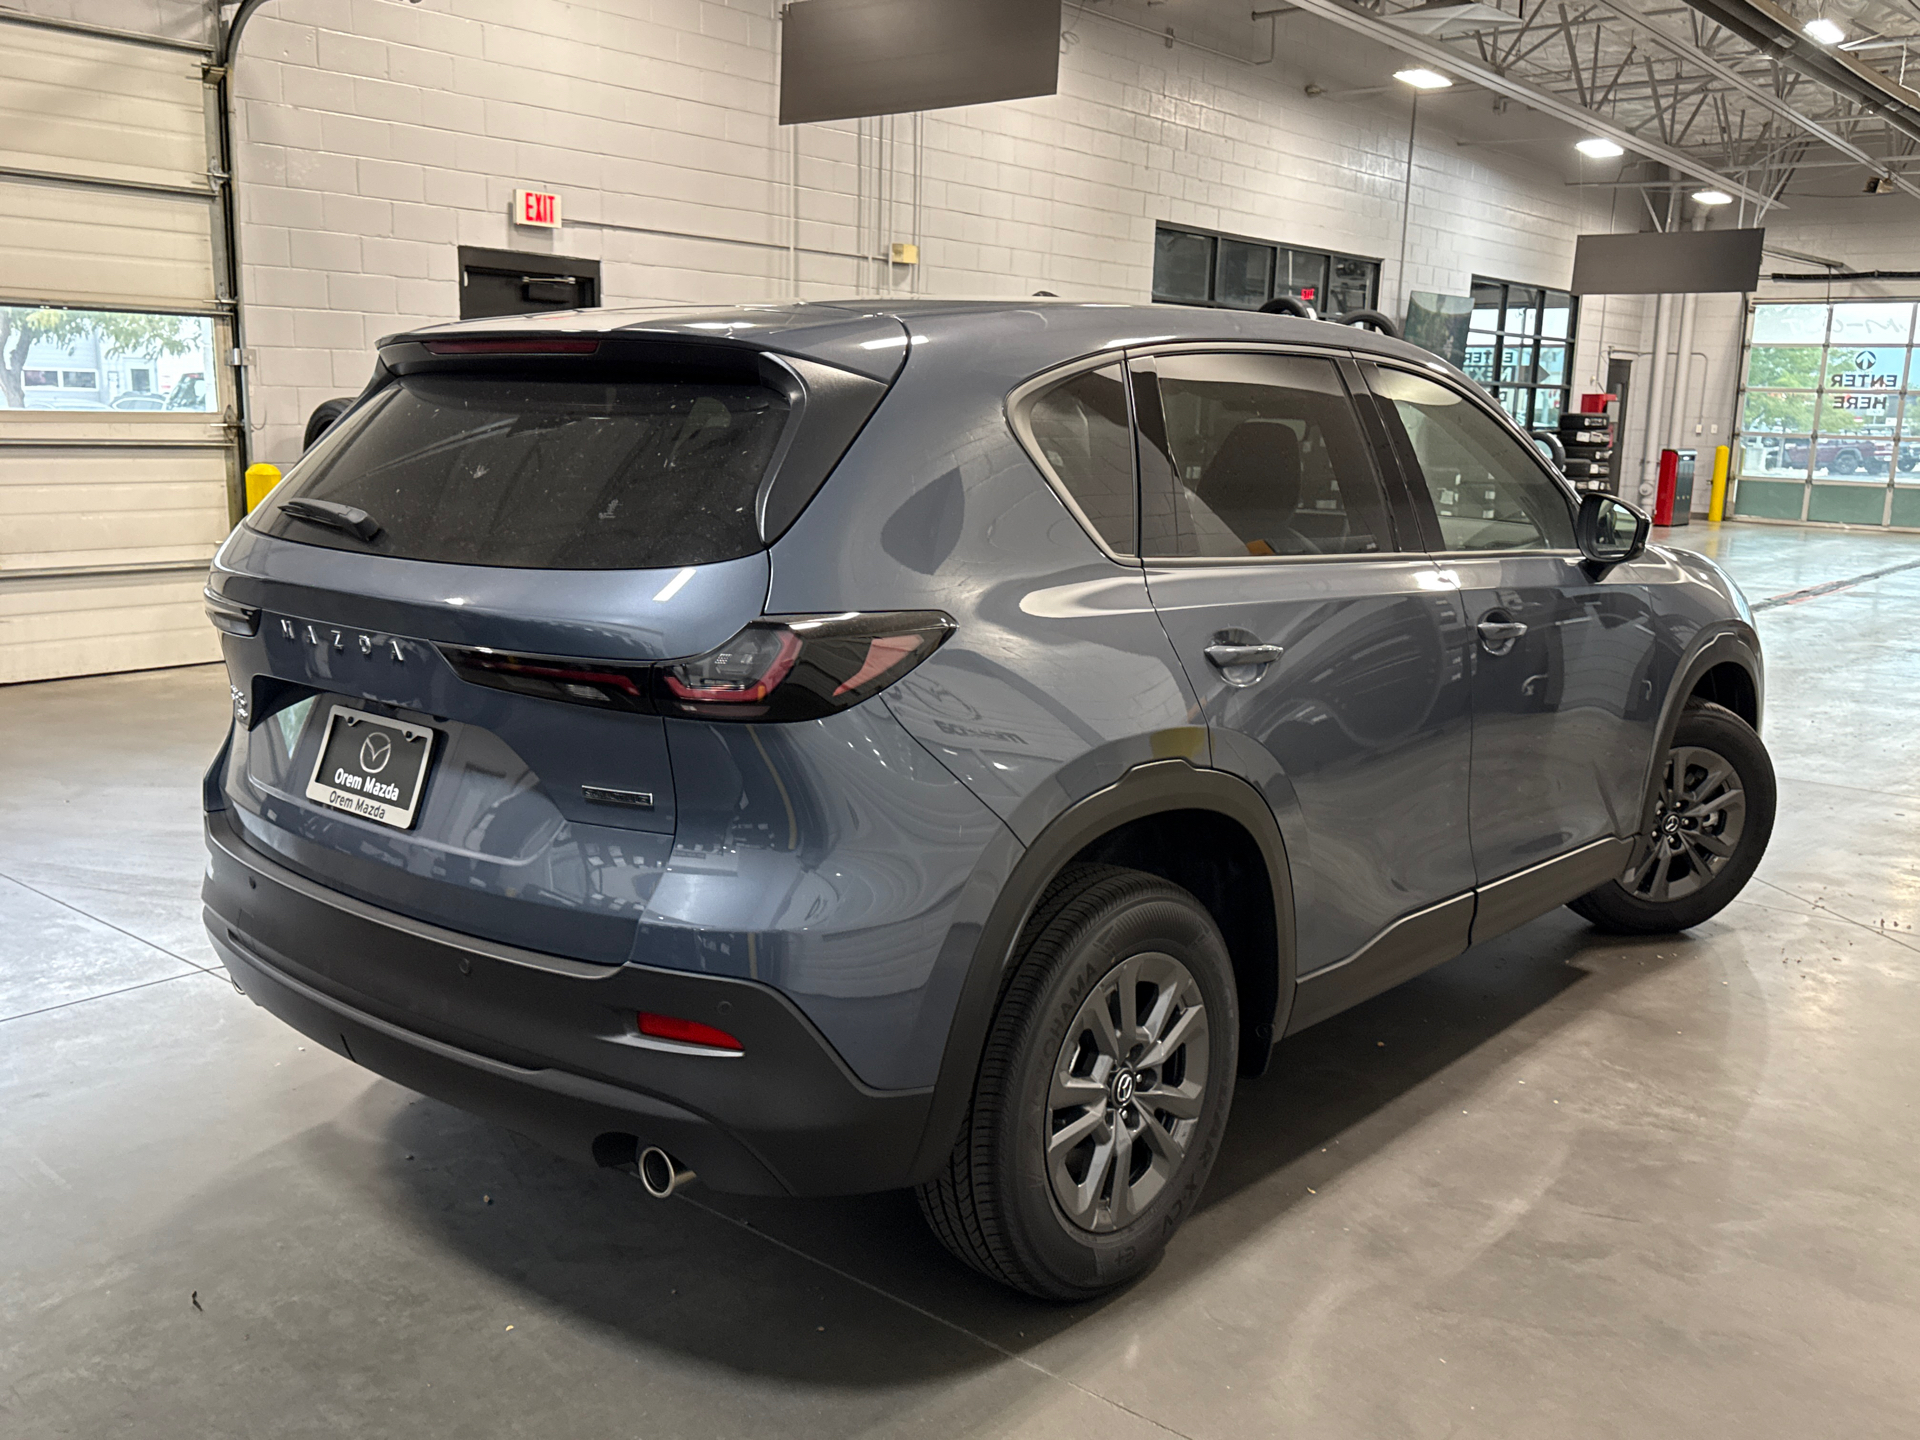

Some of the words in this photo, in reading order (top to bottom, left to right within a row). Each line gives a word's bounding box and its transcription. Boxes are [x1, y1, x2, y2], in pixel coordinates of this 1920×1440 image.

[525, 192, 555, 224] EXIT
[281, 619, 404, 661] MAZDA
[334, 768, 363, 790] Orem
[363, 776, 399, 802] Mazda
[329, 791, 354, 809] Orem
[355, 798, 386, 819] Mazda
